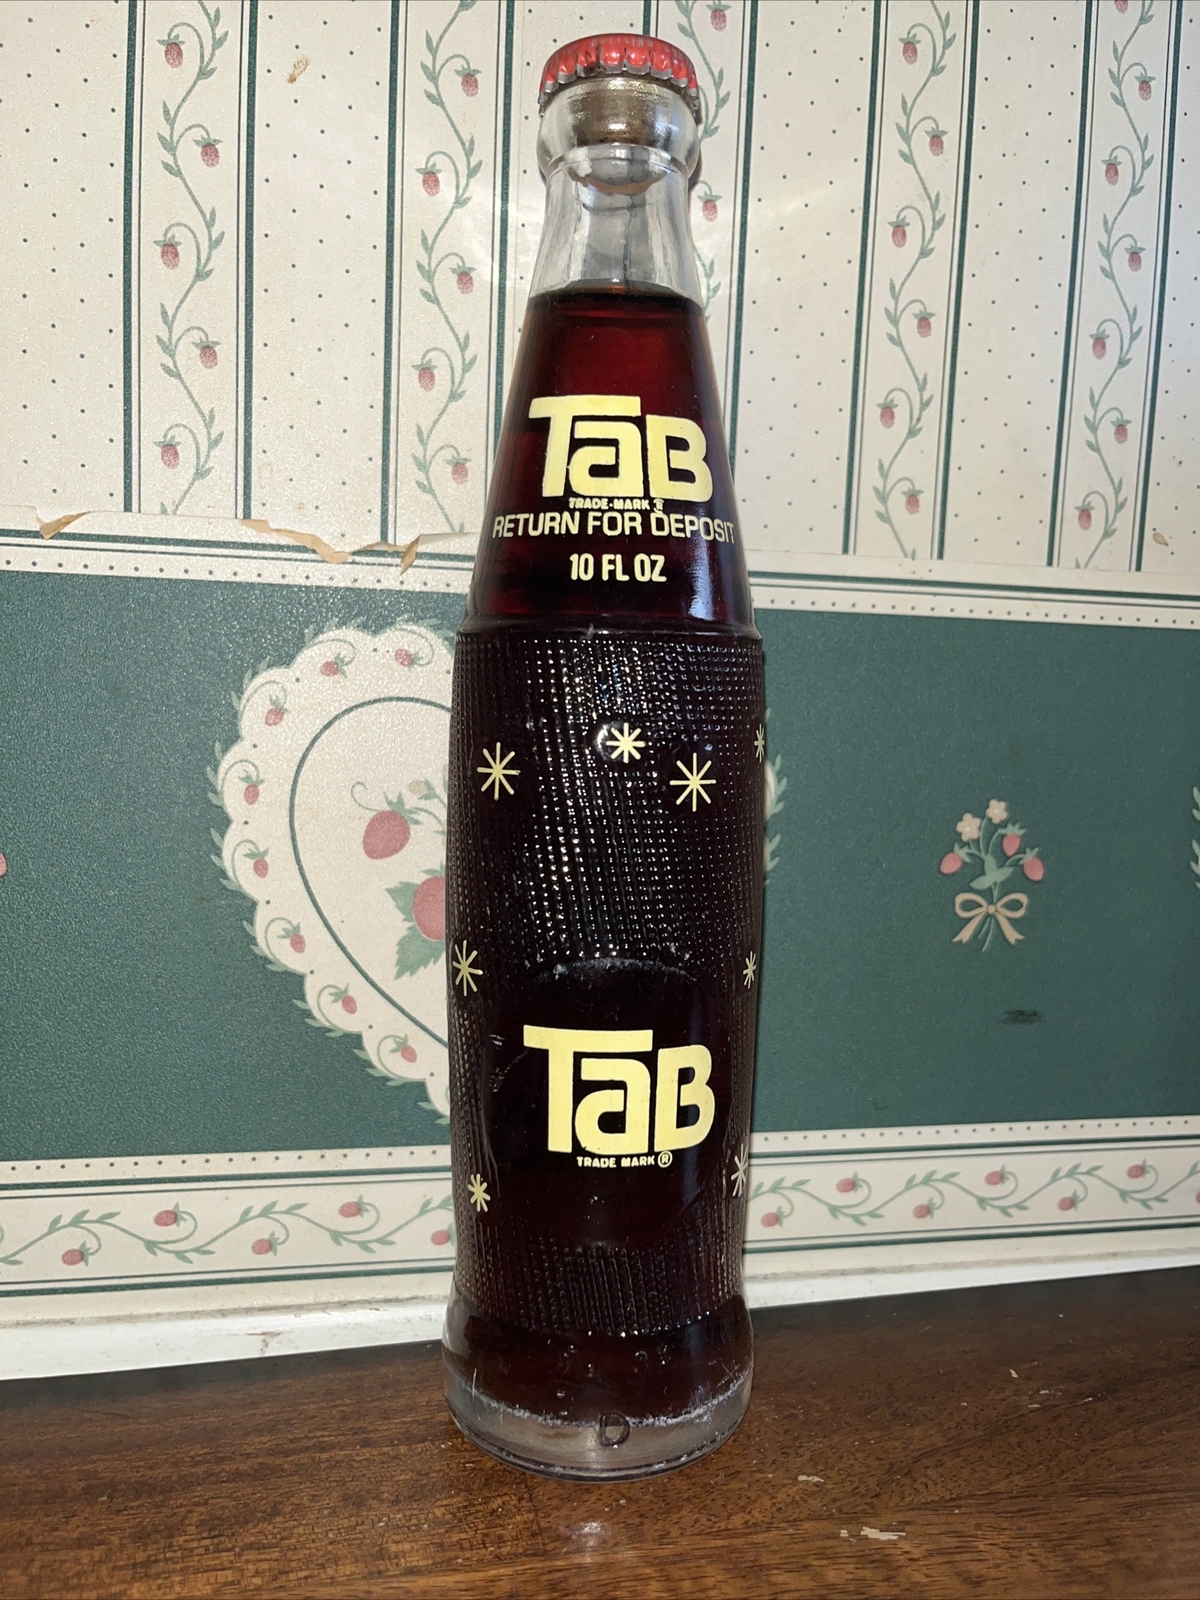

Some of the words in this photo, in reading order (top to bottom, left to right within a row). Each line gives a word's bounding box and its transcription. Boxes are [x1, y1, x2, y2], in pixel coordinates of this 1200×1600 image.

[492, 511, 581, 539] RETURN
[587, 511, 643, 537] FOR
[650, 513, 735, 545] DEPOSIT
[569, 553, 595, 581] 10
[601, 554, 630, 582] FL
[633, 553, 667, 583] OZ
[576, 1156, 617, 1168] TRADE
